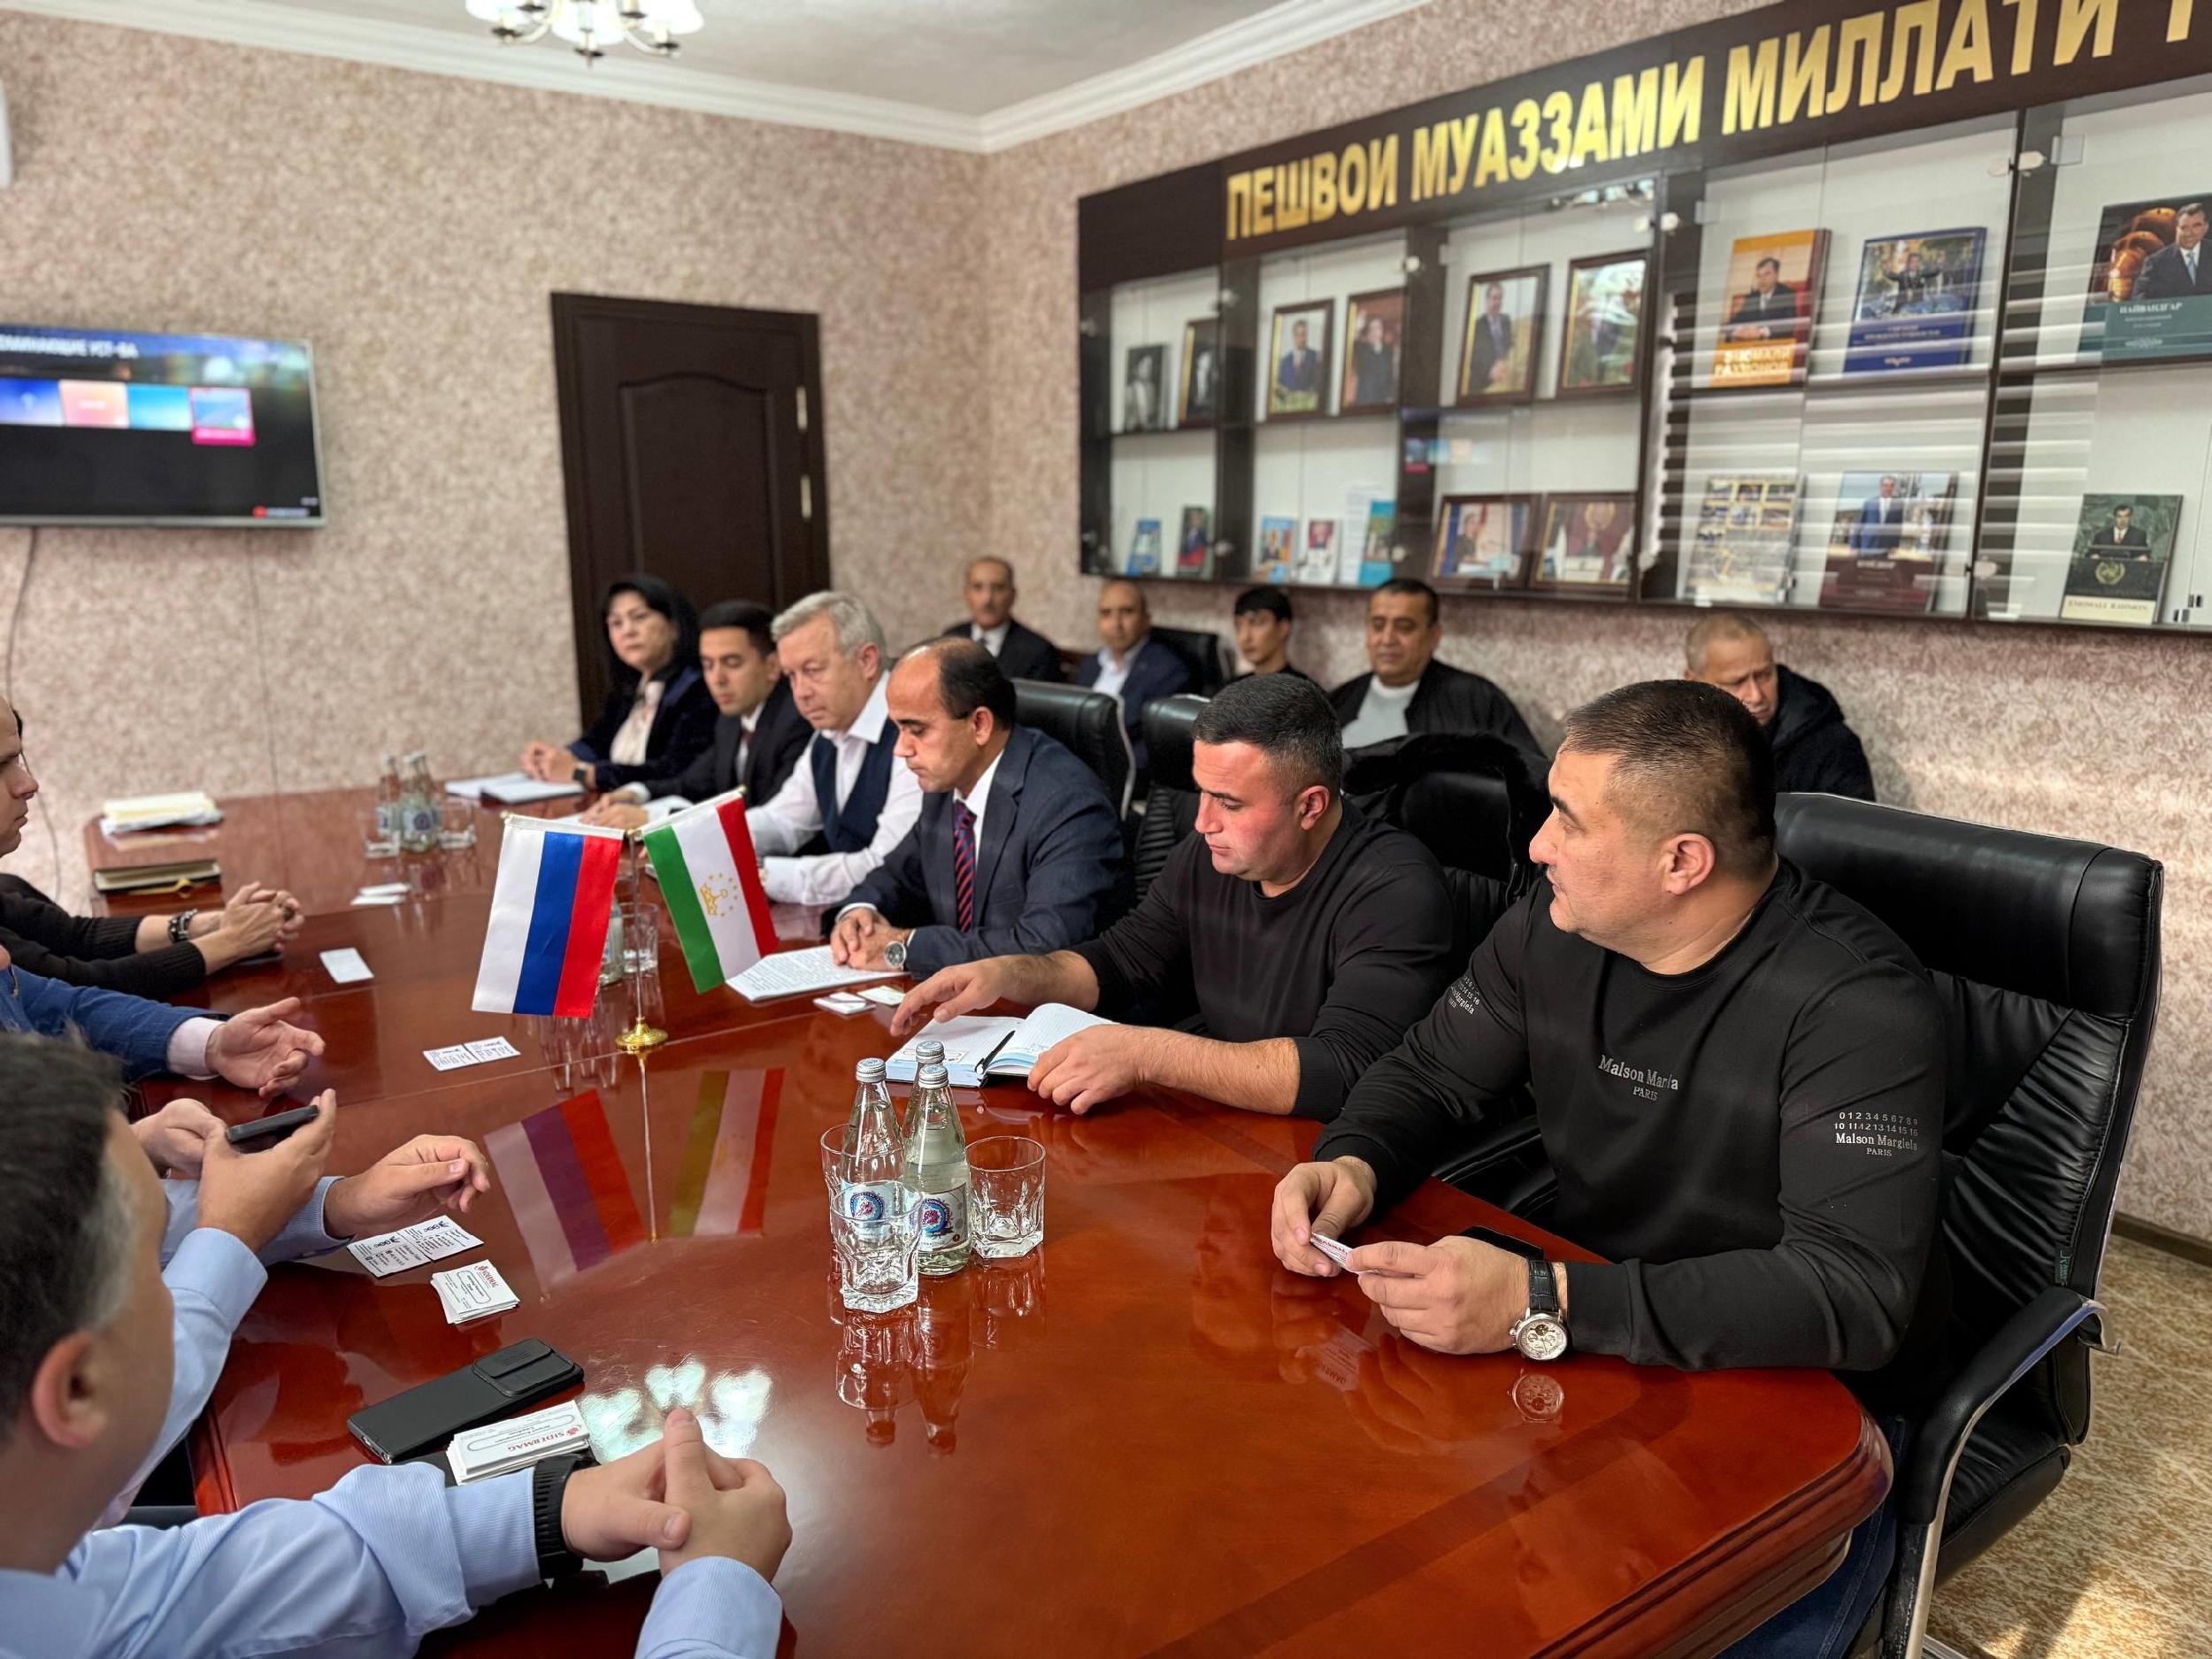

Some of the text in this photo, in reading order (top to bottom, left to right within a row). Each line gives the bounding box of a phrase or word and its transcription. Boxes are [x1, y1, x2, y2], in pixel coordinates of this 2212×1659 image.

[1226, 0, 2119, 240] ПЕШВОИ МУАЗЗАМИ МИЛЛАТИ
[1632, 1086, 1658, 1101] PARIS
[1866, 1148, 1893, 1156] PARIS
